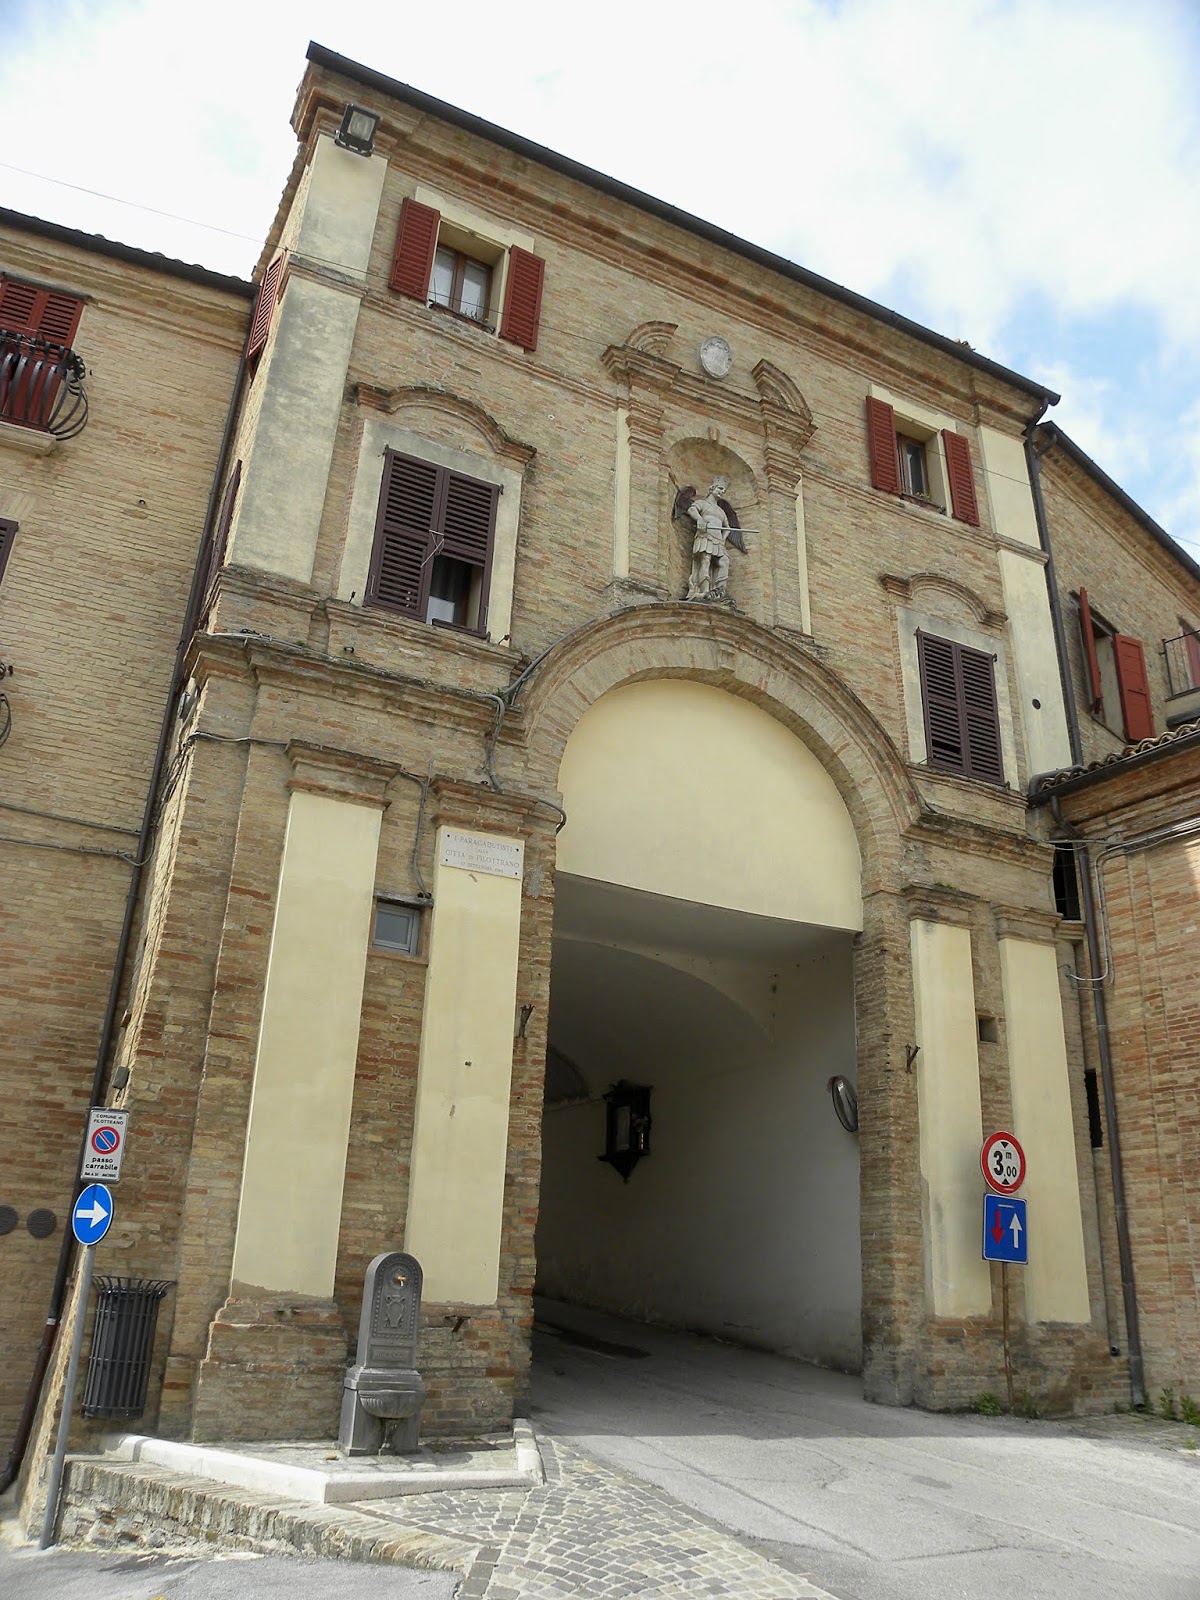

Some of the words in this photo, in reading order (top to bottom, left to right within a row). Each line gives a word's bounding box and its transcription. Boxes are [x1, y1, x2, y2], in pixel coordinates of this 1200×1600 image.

[460, 836, 513, 852] PARACADUTISTI
[476, 854, 520, 869] FILOTTRANO
[1005, 1151, 1012, 1160] m
[85, 1163, 119, 1171] carrabile
